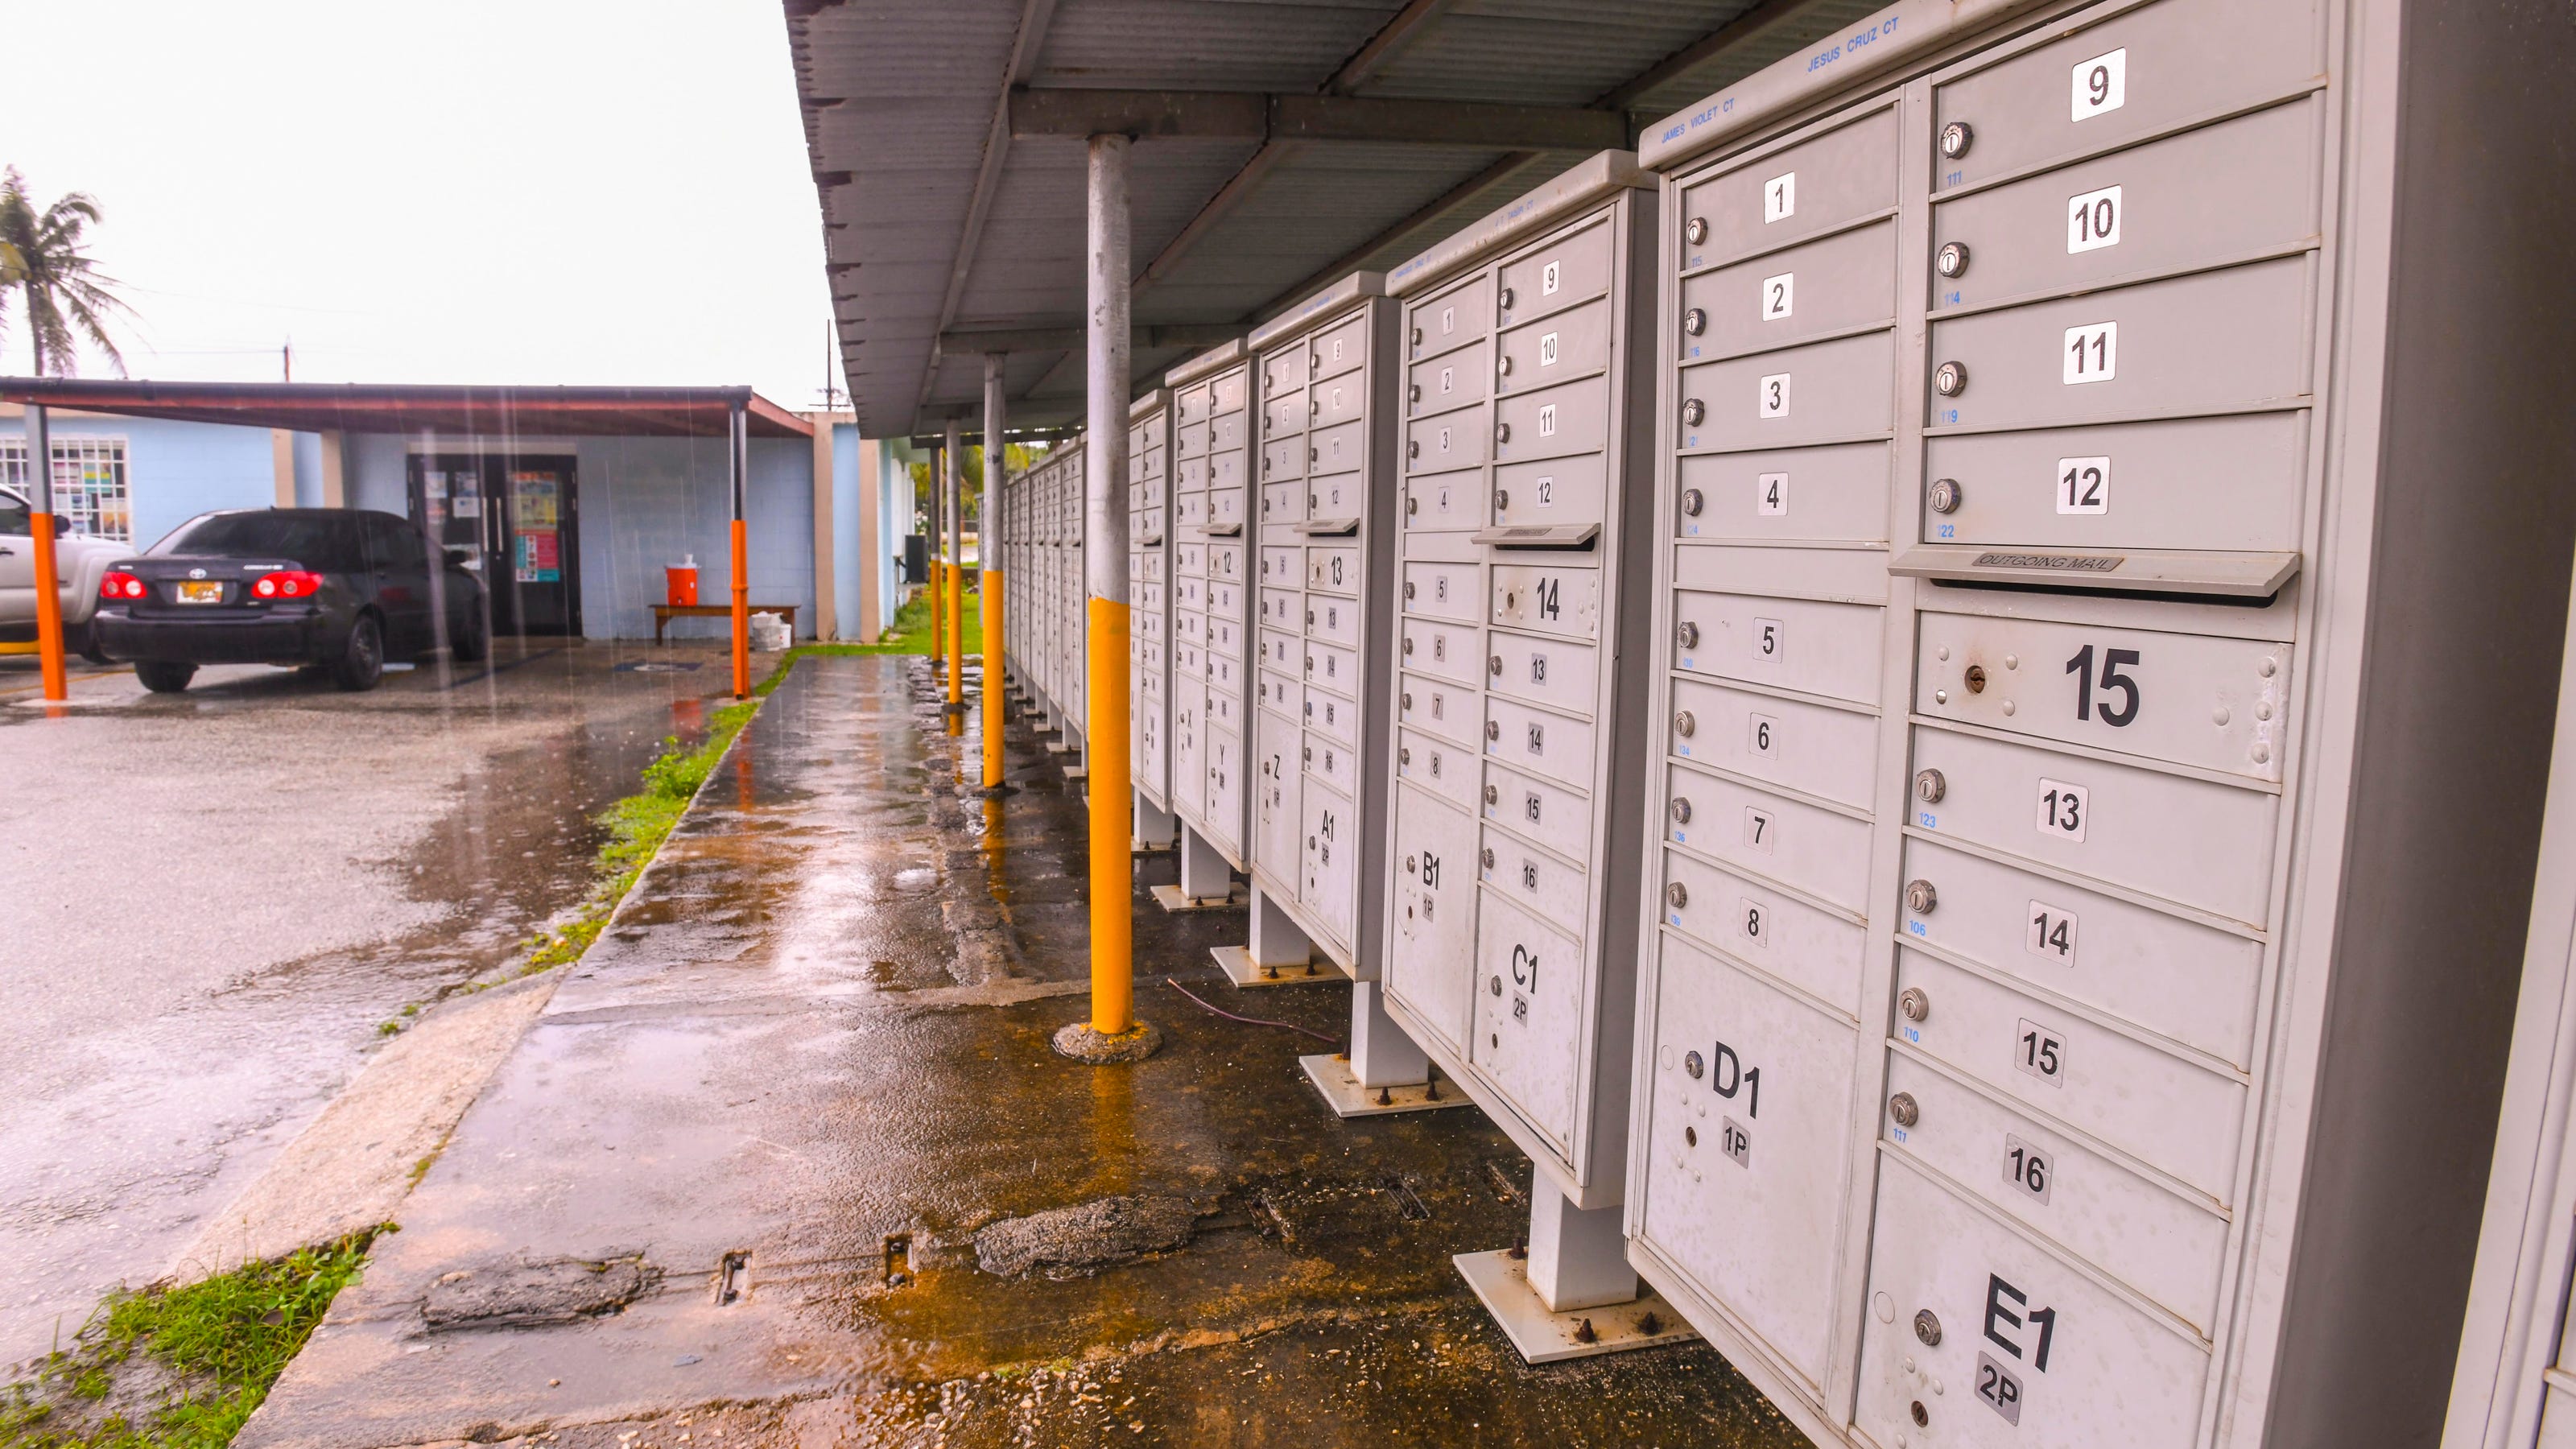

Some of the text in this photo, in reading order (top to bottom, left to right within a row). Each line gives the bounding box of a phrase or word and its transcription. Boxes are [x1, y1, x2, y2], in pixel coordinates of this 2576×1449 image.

[1807, 16, 1899, 73] JESUS CRUZ CT
[2089, 65, 2109, 106] 9
[1661, 97, 1734, 144] JAMES VIOLET CT
[1946, 170, 1962, 187] 111
[1775, 184, 1785, 213] 1
[2075, 198, 2113, 242] 10
[1548, 266, 1555, 289] 9
[1773, 283, 1784, 312] 2
[1945, 291, 1960, 306] 114
[1446, 311, 1451, 330] 1
[1543, 337, 1555, 360] 10
[2071, 332, 2107, 374] 11
[1444, 372, 1451, 390] 2
[1769, 381, 1781, 411] 3
[1542, 409, 1554, 432] 11
[1941, 409, 1958, 423] 119
[1333, 440, 1339, 455] 11
[1443, 430, 1448, 449] 3
[1332, 489, 1339, 504] 12
[1538, 482, 1550, 504] 12
[1767, 479, 1779, 509] 4
[2063, 467, 2102, 506] 12
[1441, 490, 1447, 509] 4
[1937, 524, 1955, 539] 122
[1224, 551, 1231, 573] 12
[1331, 556, 1342, 585] 13
[1979, 555, 2107, 570] OUTGOING MAIL
[1439, 580, 1444, 598] 5
[1537, 577, 1559, 621] 14
[1329, 610, 1336, 626] 13
[1437, 639, 1442, 657] 6
[1763, 625, 1774, 654] 5
[1328, 658, 1335, 674] 14
[1533, 658, 1544, 681] 13
[2066, 645, 2140, 727] 15
[1327, 705, 1333, 721] 15
[1435, 698, 1440, 715] 7
[1530, 728, 1541, 750] 14
[1758, 721, 1769, 750] 6
[1326, 753, 1332, 770] 16
[1433, 756, 1439, 774] 8
[1527, 796, 1538, 820] 15
[2043, 789, 2079, 832] 13
[1322, 809, 1334, 842] A1
[1754, 815, 1765, 844] 7
[1919, 812, 1936, 829] 123
[1674, 830, 1686, 843] 136
[1322, 847, 1328, 863] 2P
[1423, 850, 1439, 890] B1
[1524, 864, 1536, 889] 16
[1423, 896, 1433, 918] 1P
[1748, 908, 1759, 937] 8
[1909, 919, 1926, 937] 106
[2033, 912, 2070, 956] 14
[1513, 943, 1538, 994] C1
[1513, 997, 1527, 1021] 2P
[1904, 1026, 1919, 1043] 110
[2023, 1031, 2058, 1076] 15
[1713, 1041, 1761, 1120] D1
[1724, 1125, 1747, 1158] 1P
[1893, 1128, 1907, 1144] 111
[2010, 1148, 2045, 1193] 16
[1984, 1272, 2056, 1373] E1
[1979, 1366, 2018, 1408] 2P
